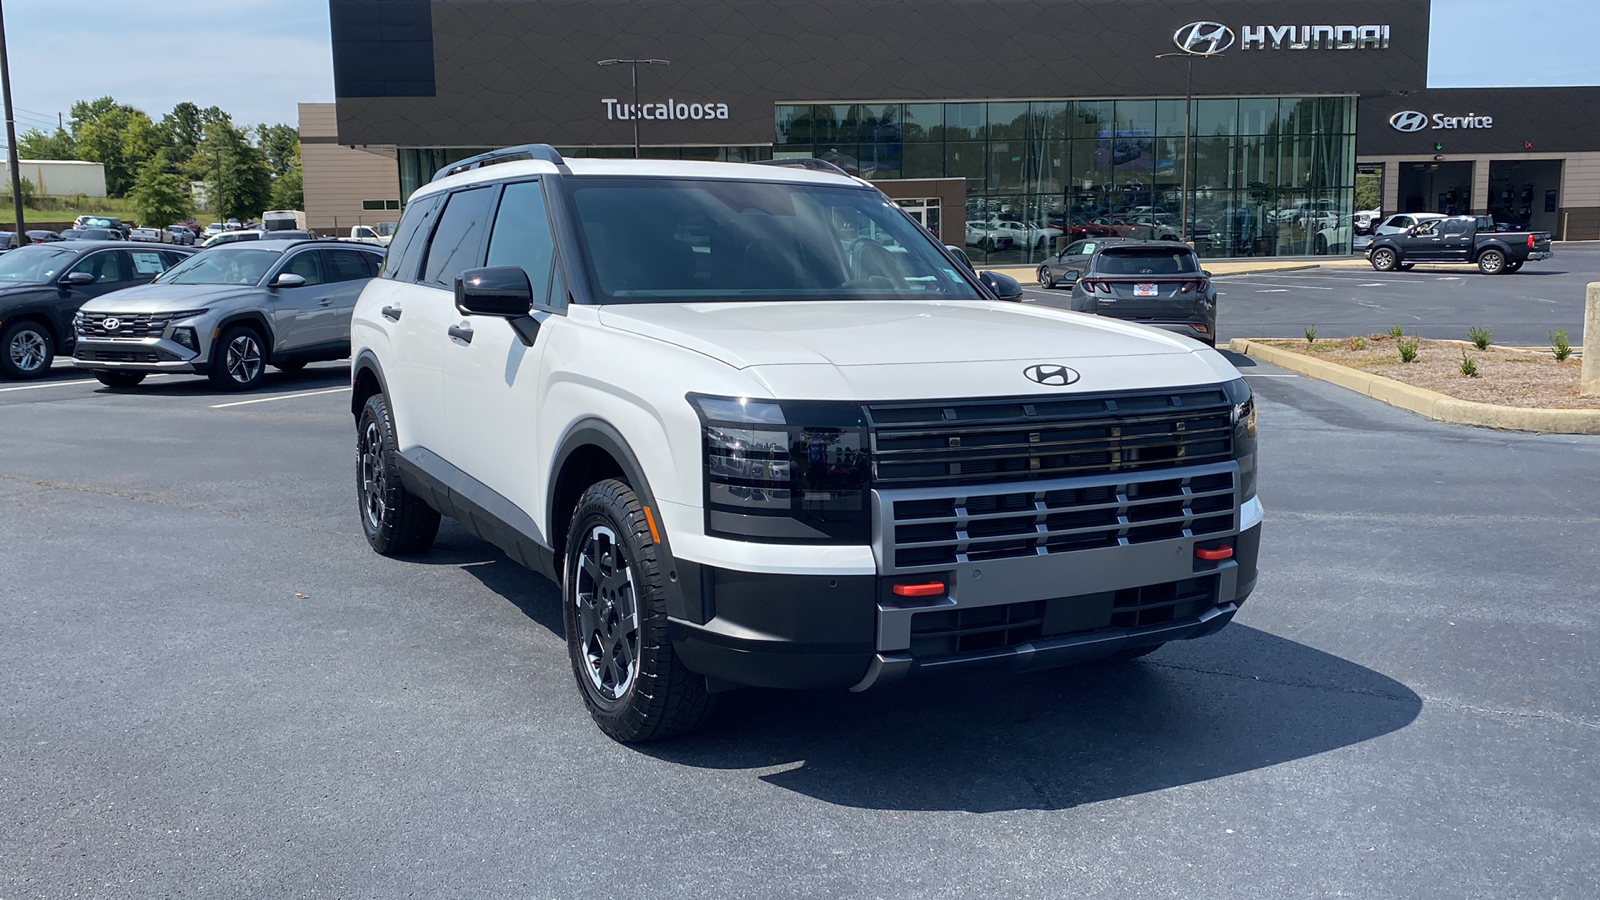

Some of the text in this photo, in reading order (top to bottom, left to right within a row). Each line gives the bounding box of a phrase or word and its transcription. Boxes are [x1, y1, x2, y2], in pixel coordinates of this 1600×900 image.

[1241, 25, 1390, 50] HYUNDAI
[601, 98, 729, 120] Tuscaloosa
[1432, 112, 1493, 129] Service
